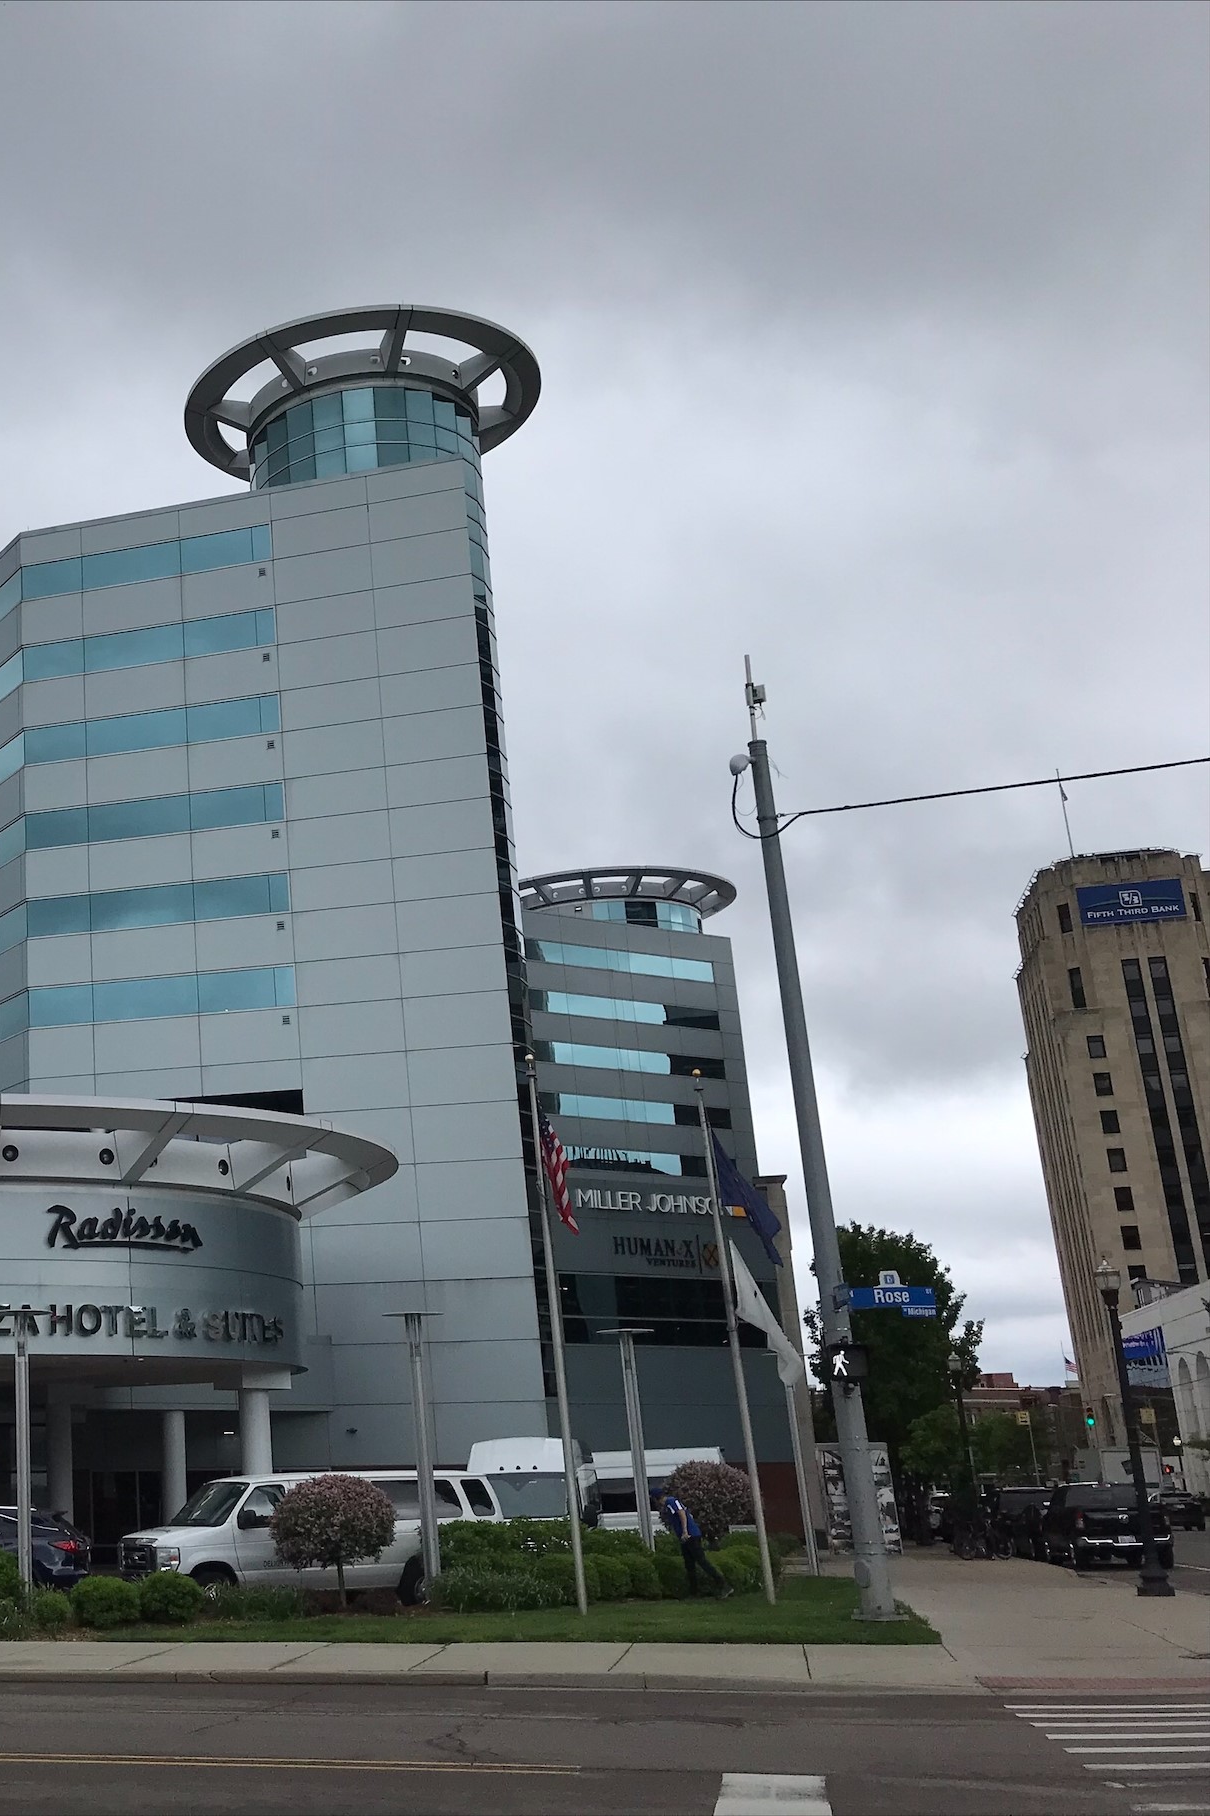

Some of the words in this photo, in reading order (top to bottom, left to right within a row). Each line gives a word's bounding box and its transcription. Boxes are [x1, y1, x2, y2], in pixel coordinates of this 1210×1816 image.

[1086, 910, 1115, 919] FIFTH
[1117, 907, 1149, 917] THIRD
[1151, 904, 1180, 913] BANK
[574, 1188, 642, 1212] MILLER
[46, 1204, 203, 1252] Radisson
[612, 1236, 676, 1257] HUMAN
[645, 1257, 697, 1268] VENTURES
[873, 1288, 910, 1304] Rose
[907, 1307, 937, 1317] Michigan
[48, 1303, 169, 1339] HOTEL
[172, 1308, 198, 1340] &
